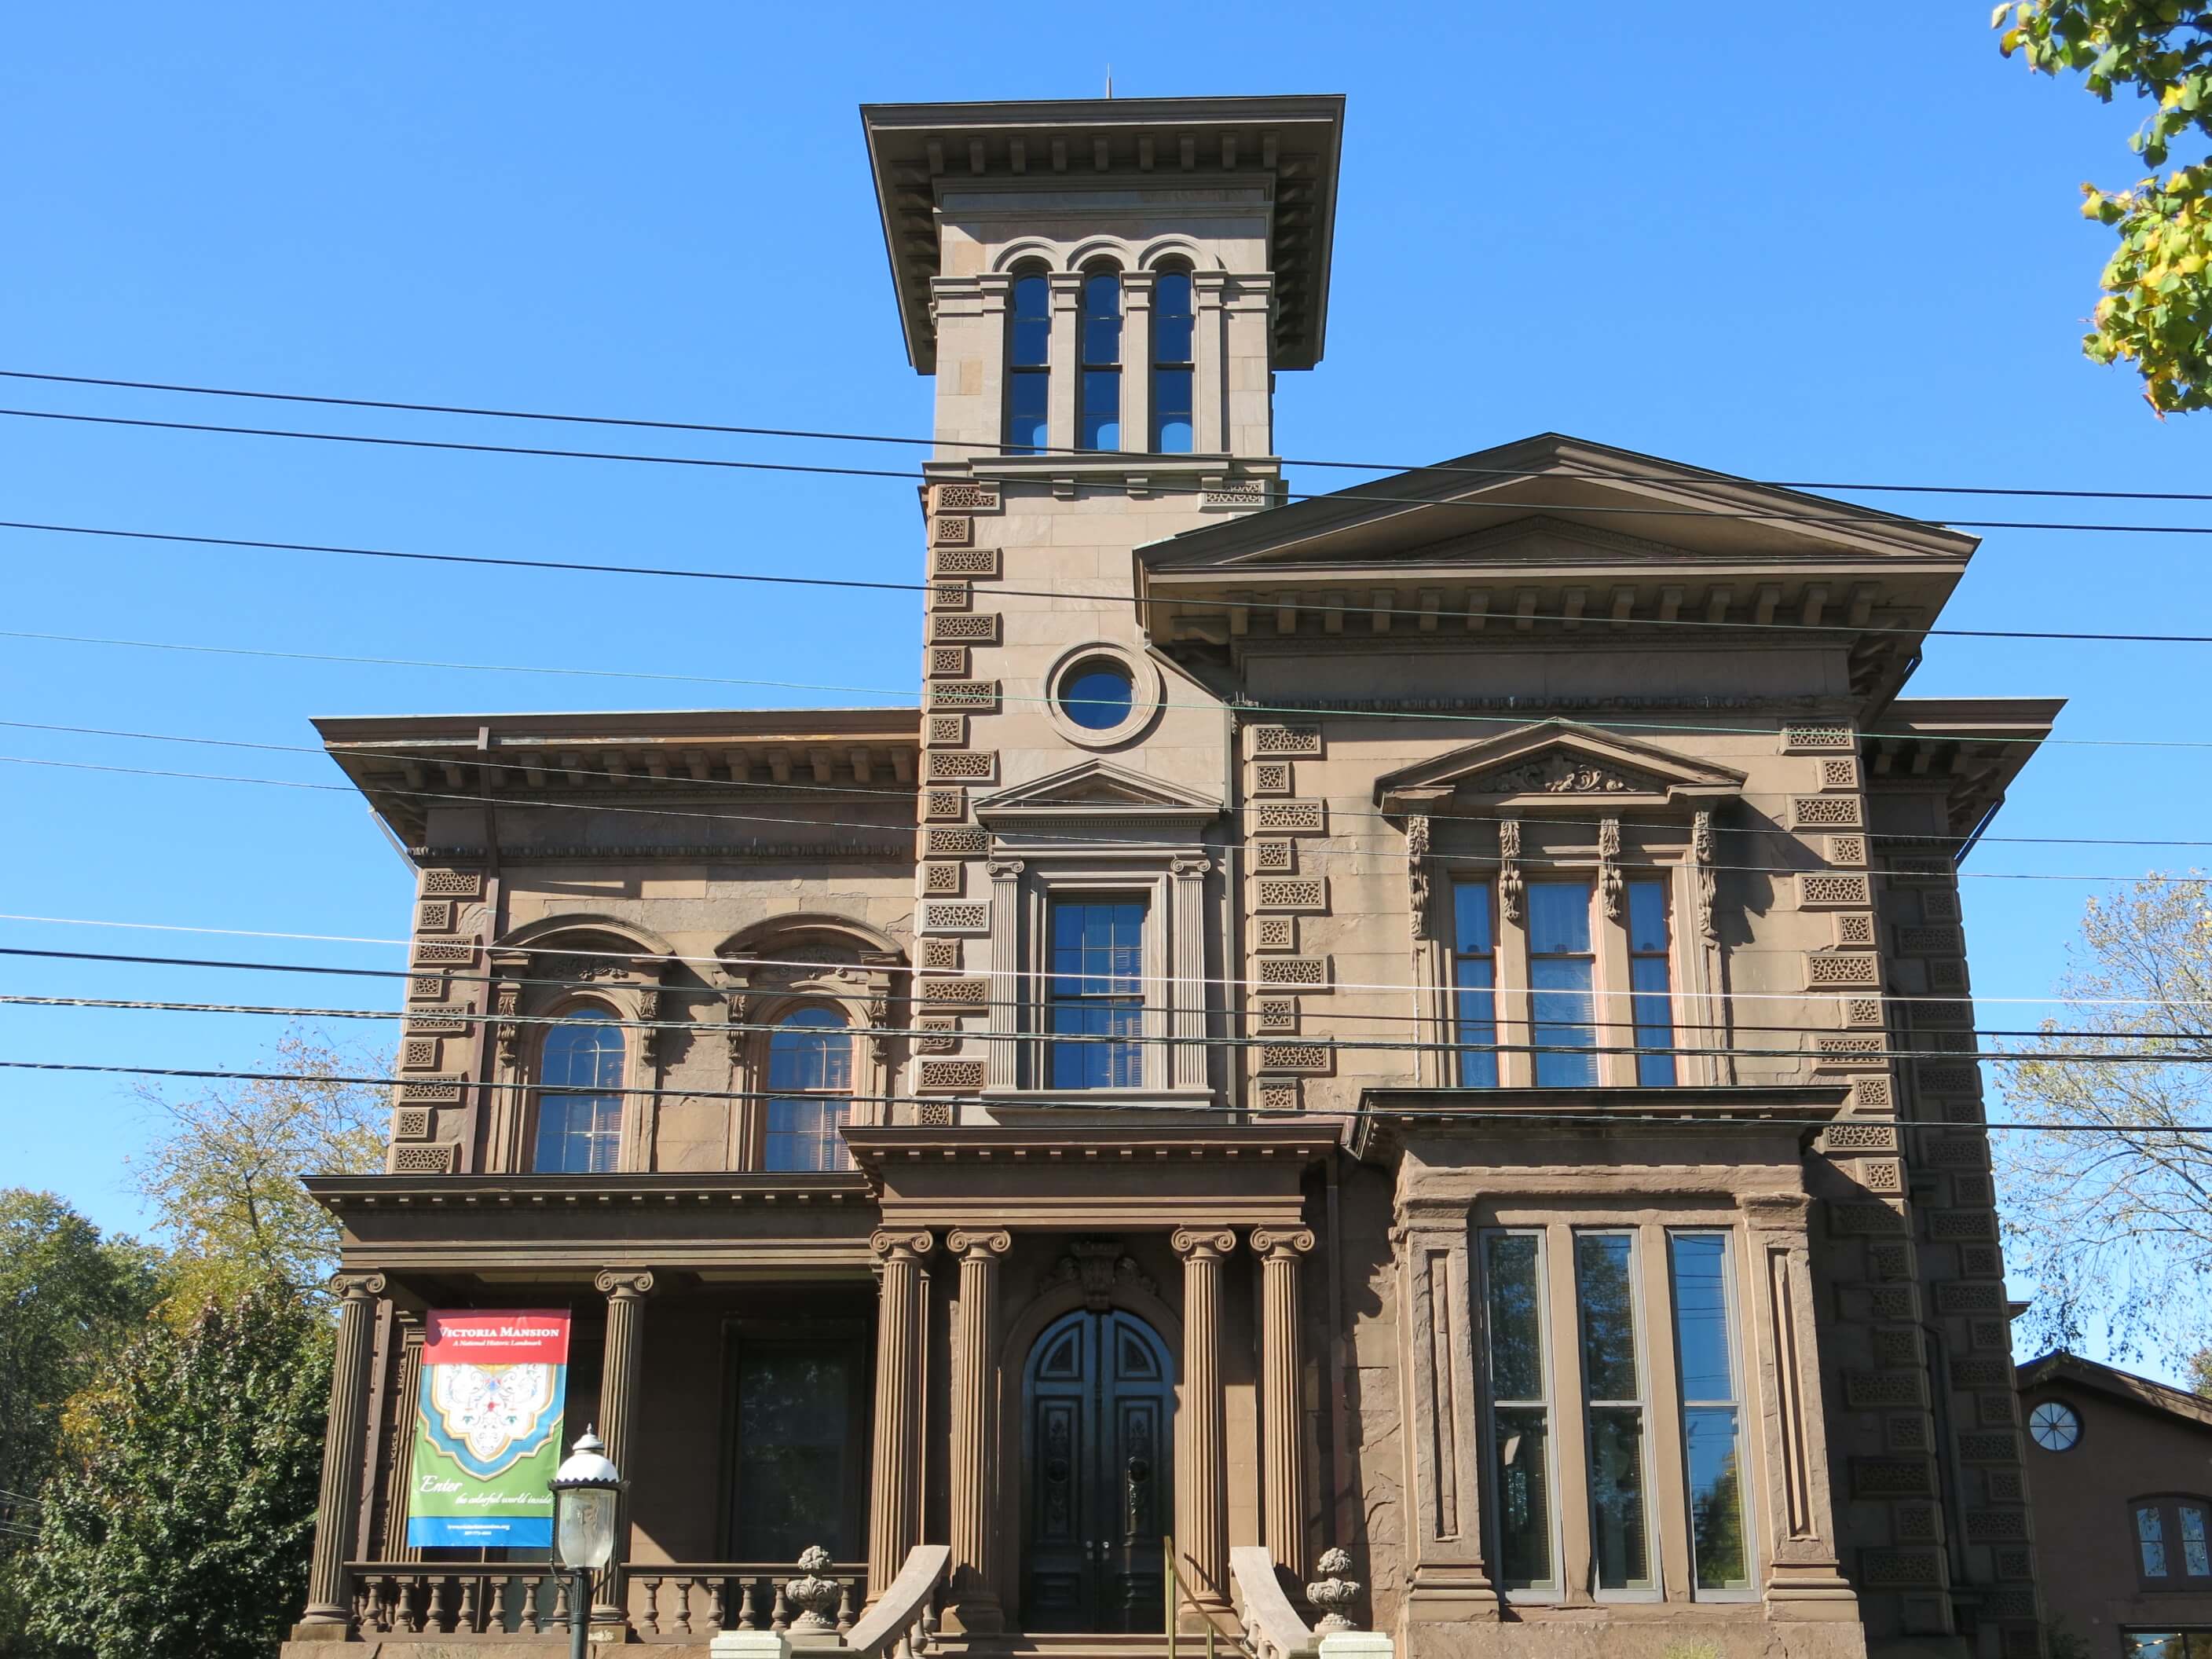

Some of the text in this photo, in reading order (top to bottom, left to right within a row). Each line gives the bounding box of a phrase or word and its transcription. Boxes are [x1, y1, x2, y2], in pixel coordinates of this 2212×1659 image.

[500, 1327, 559, 1338] MANSION
[420, 1475, 463, 1492] Enter
[502, 1492, 529, 1504] world
